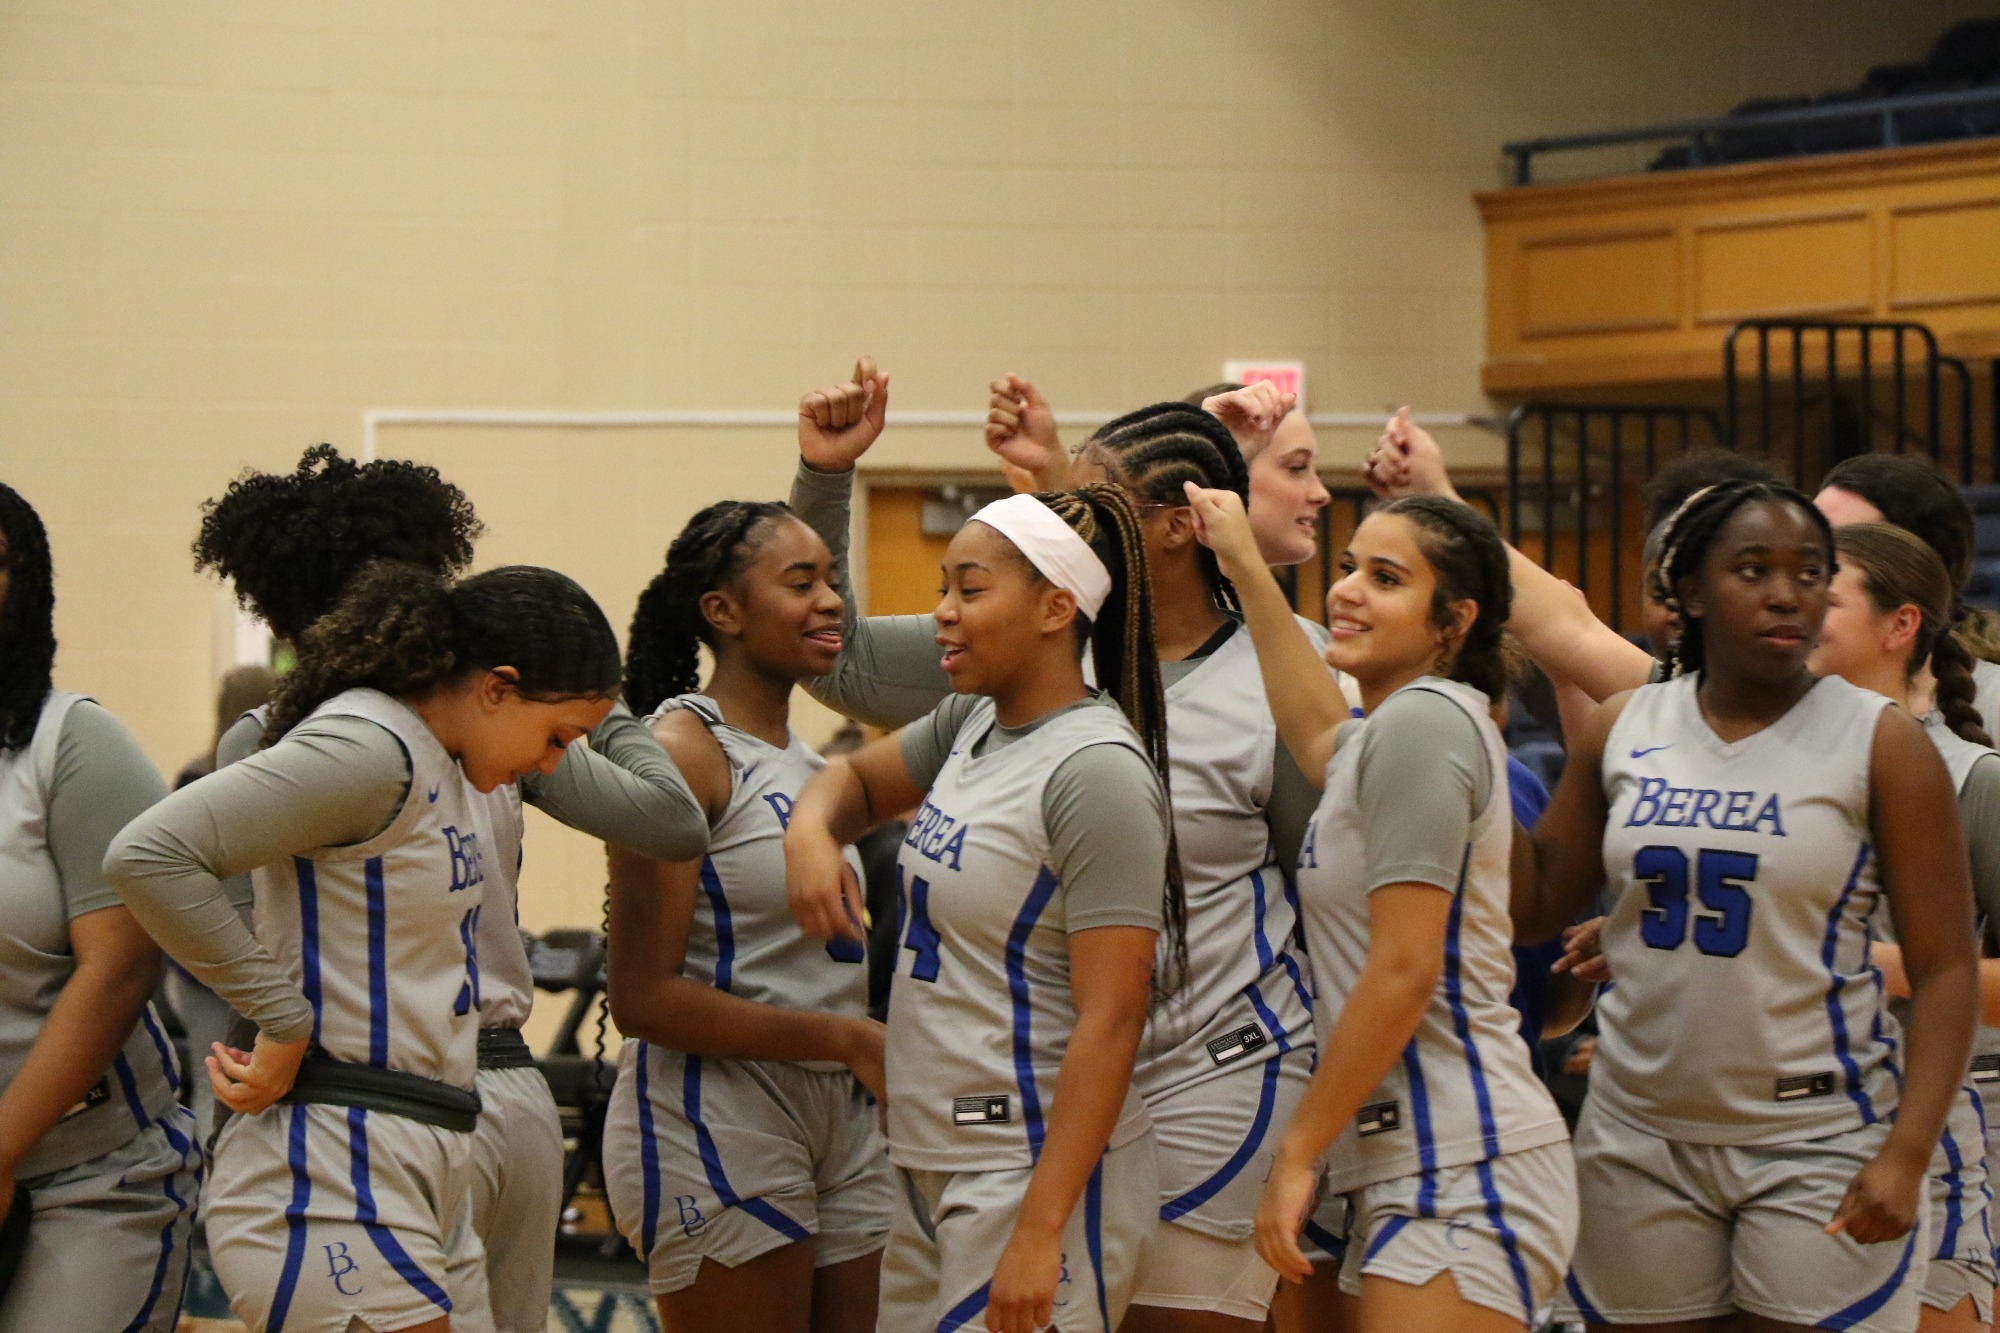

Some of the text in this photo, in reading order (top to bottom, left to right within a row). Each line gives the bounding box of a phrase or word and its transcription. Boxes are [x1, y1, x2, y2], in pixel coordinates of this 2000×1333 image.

[904, 787, 968, 872] EREA
[1623, 776, 1788, 837] BEREA
[1633, 845, 1759, 958] 35
[1243, 1031, 1260, 1043] 3XL
[990, 1104, 1003, 1115] M
[322, 1241, 364, 1296] BC
